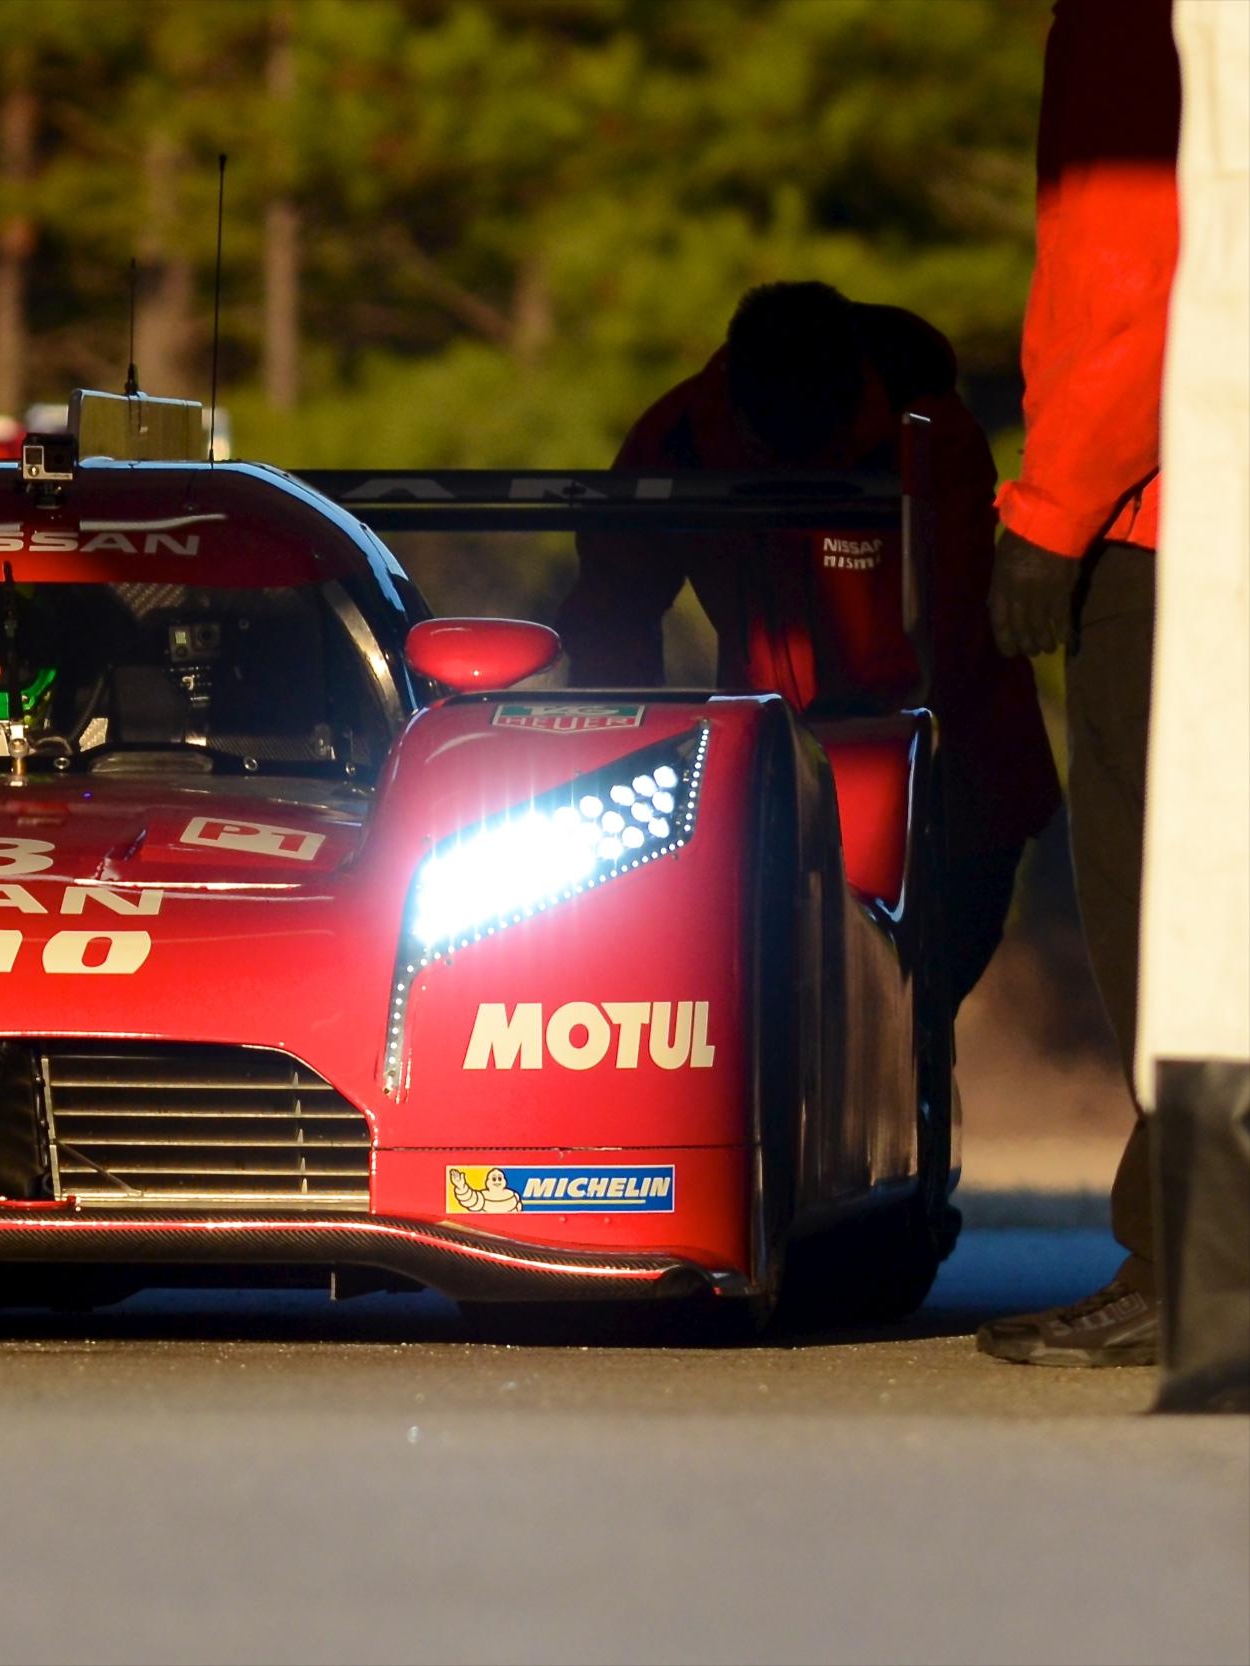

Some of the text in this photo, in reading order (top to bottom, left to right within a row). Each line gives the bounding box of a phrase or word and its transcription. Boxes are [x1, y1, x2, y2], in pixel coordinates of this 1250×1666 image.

[823, 554, 882, 571] nism
[504, 716, 629, 730] HEUER
[198, 821, 306, 853] P1
[462, 1001, 715, 1070] MOTUL
[522, 1177, 671, 1198] MICHELIN
